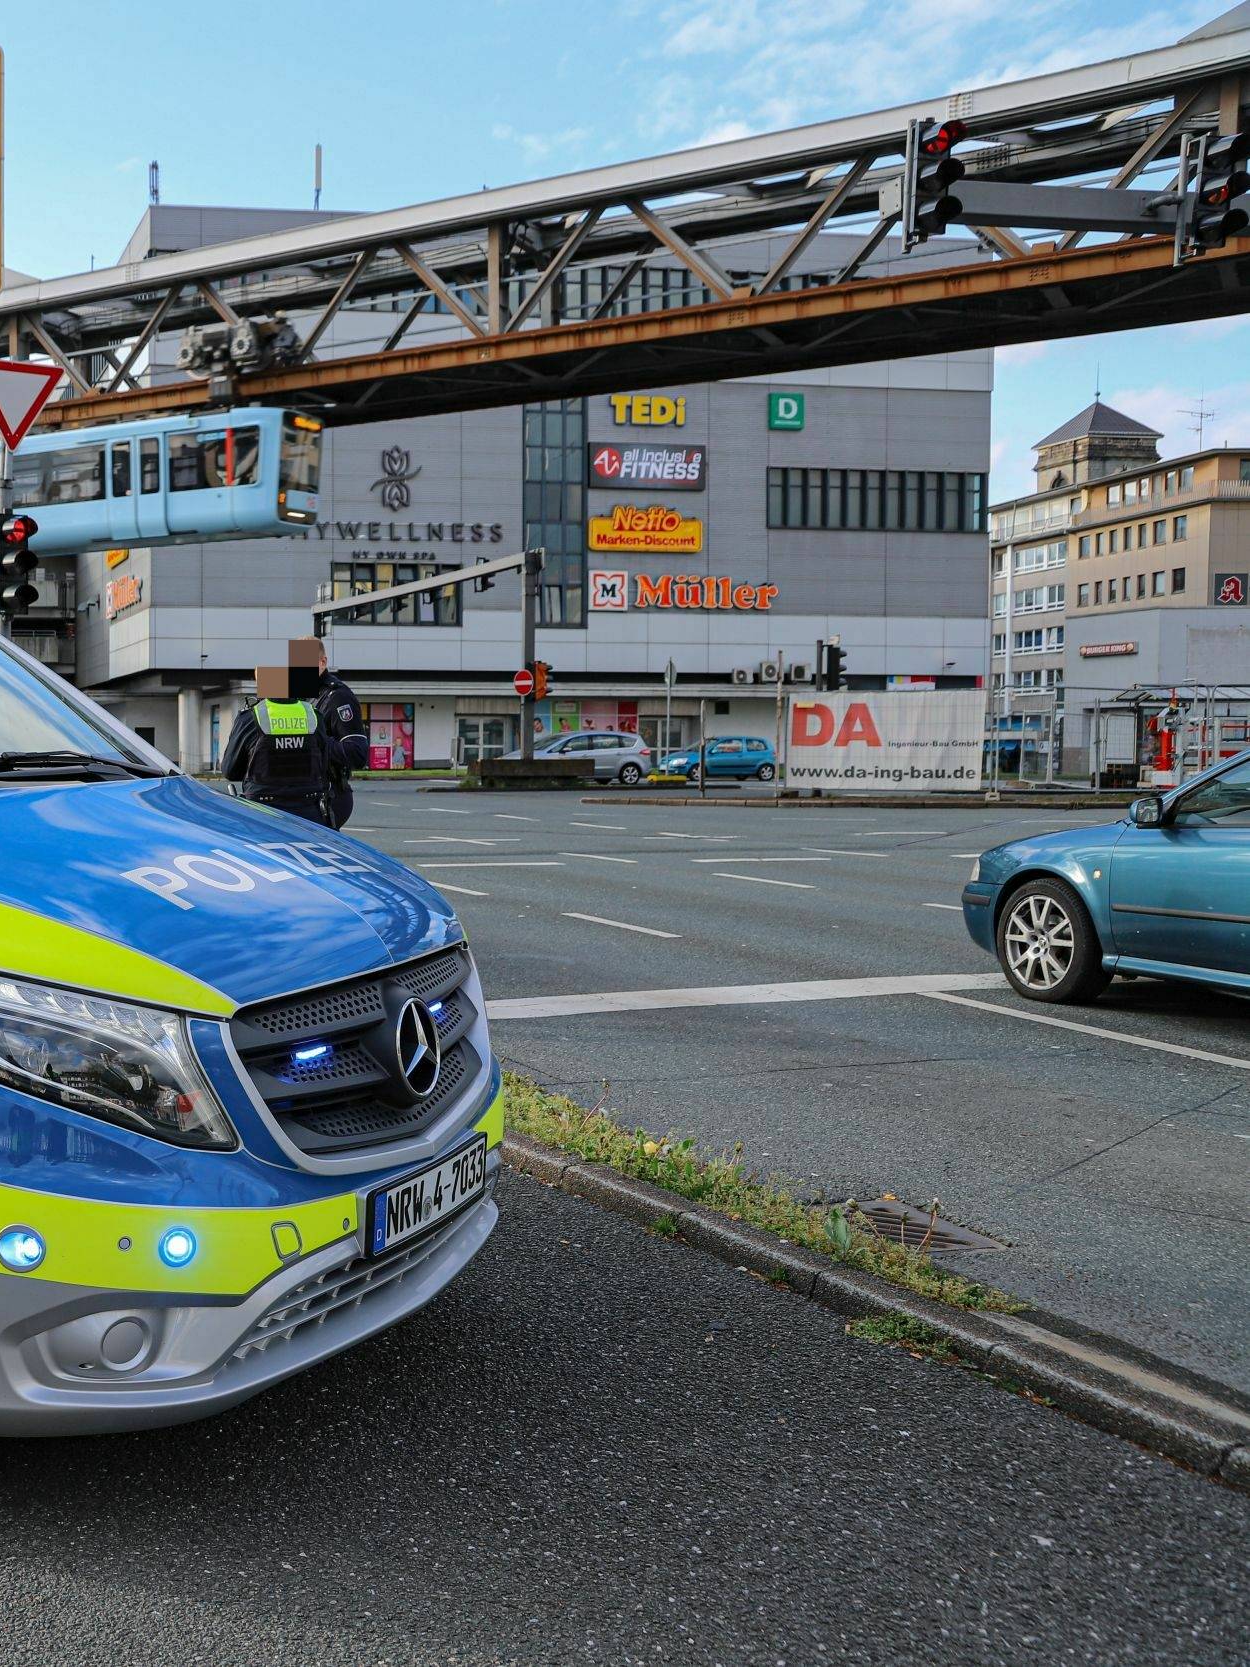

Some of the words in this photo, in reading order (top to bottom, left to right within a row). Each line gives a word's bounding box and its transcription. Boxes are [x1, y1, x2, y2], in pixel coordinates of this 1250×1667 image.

[610, 395, 686, 427] TEDi
[778, 397, 798, 419] D
[623, 449, 639, 463] all
[620, 463, 701, 480] FITNESS
[613, 505, 683, 533] Netto
[291, 521, 503, 543] YWELLNESS
[596, 534, 696, 547] Marken-Discount
[601, 583, 617, 598] M
[635, 574, 780, 610] Müller
[791, 702, 882, 747] DA
[275, 736, 304, 749] NRW
[791, 765, 976, 783] www.da-ing-bau.de
[119, 842, 382, 910] POLIZEI
[386, 1180, 425, 1240] NRW
[376, 1229, 382, 1242] D
